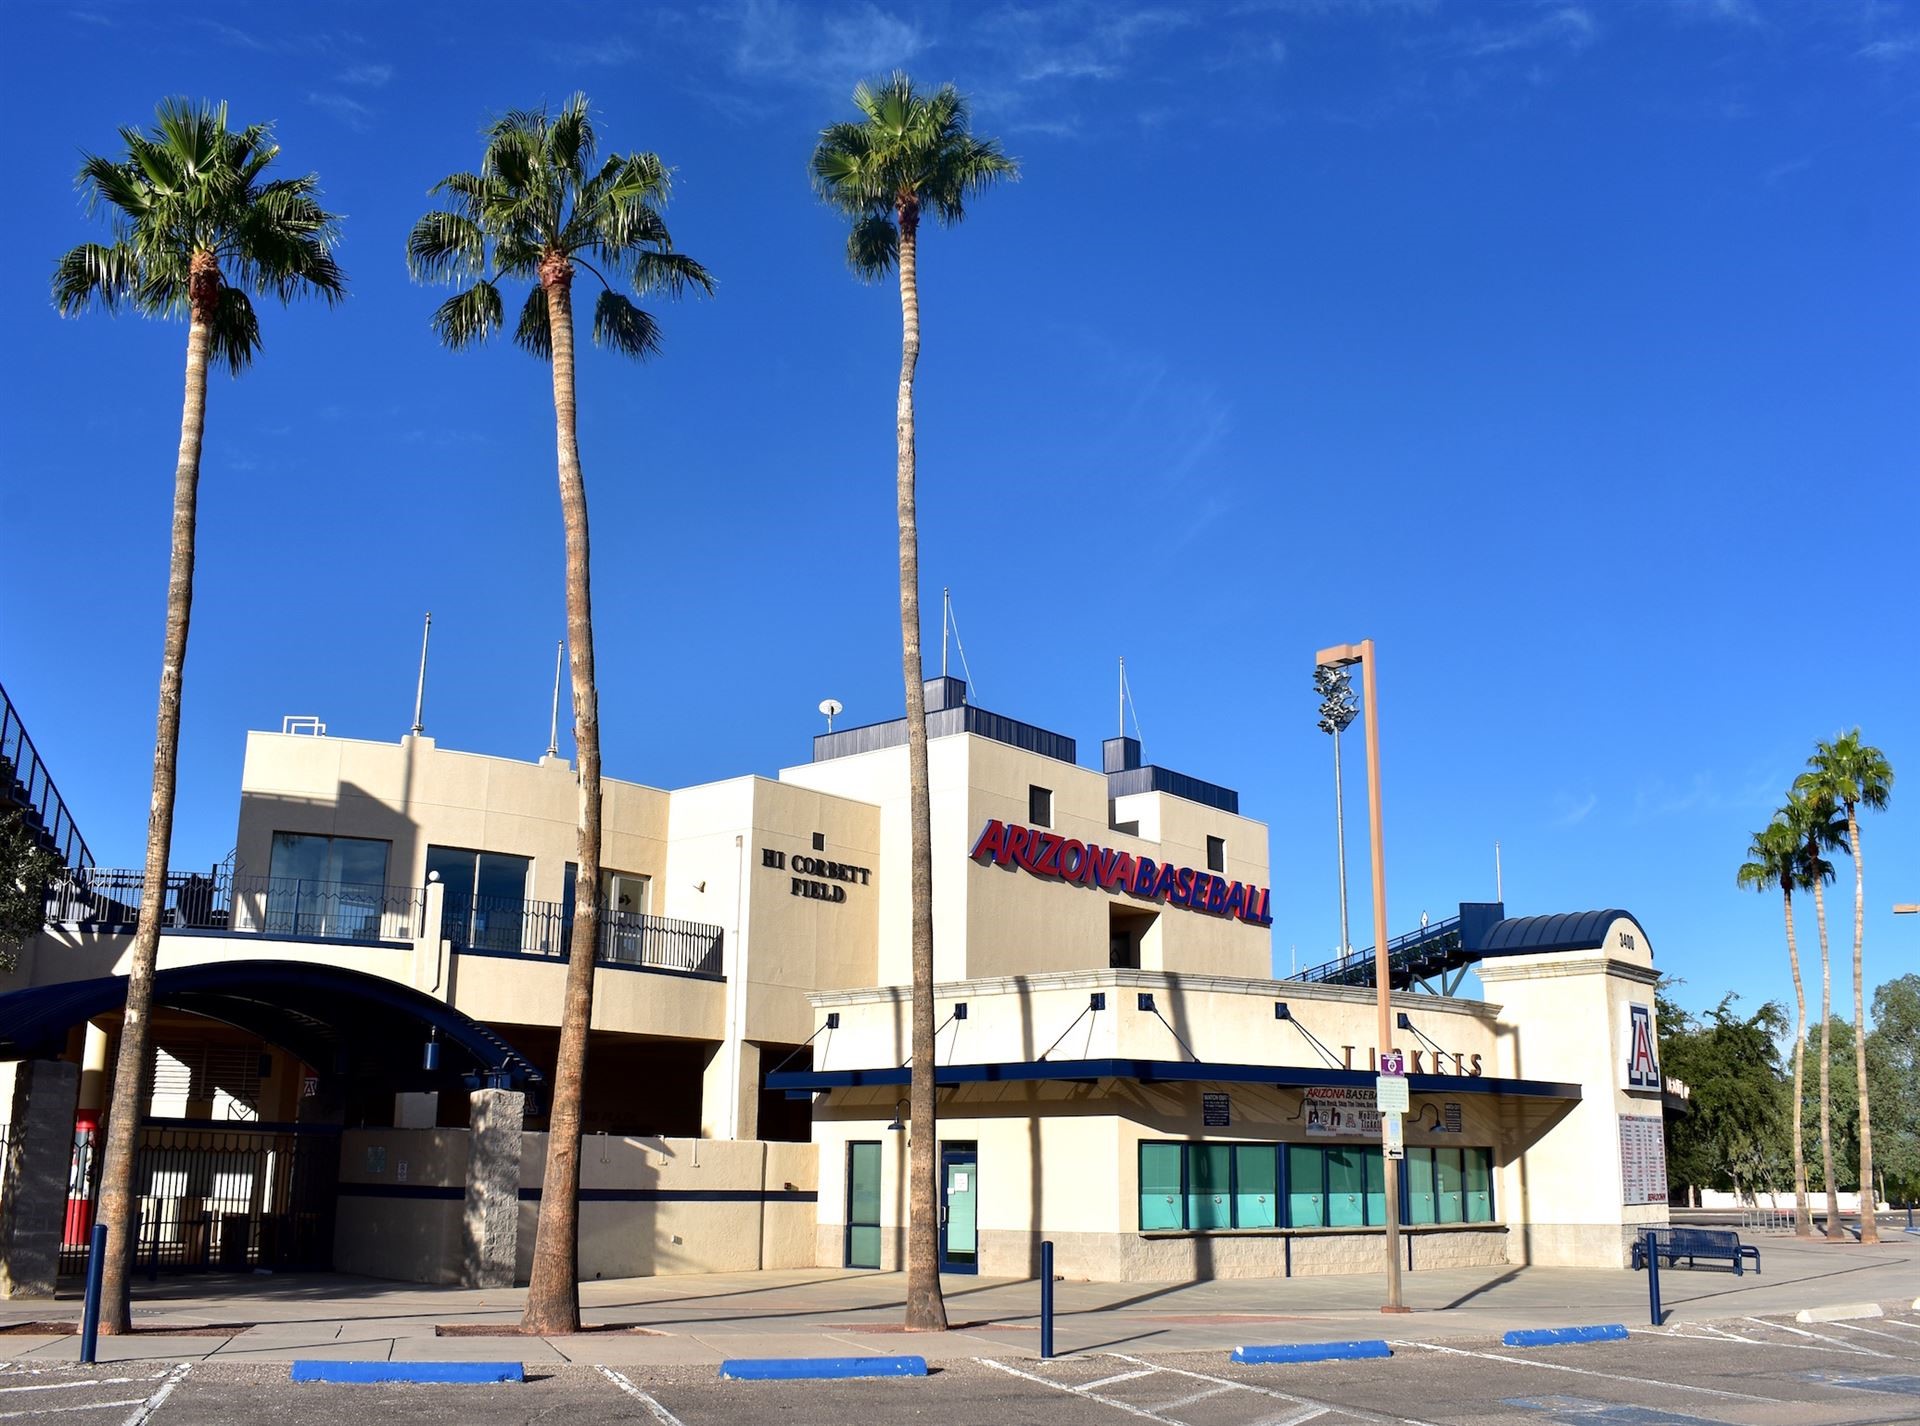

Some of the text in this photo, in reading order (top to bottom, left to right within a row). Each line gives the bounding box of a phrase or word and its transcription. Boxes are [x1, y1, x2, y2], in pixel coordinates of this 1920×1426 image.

[762, 848, 872, 886] HI CORBETT
[969, 819, 1273, 925] ARIZONA BASEBALL
[790, 877, 847, 904] FIELD
[1619, 932, 1635, 951] 3400
[1341, 1045, 1482, 1077] TIKETS
[1628, 1005, 1660, 1088] A
[1306, 1088, 1345, 1099] ARIZONA
